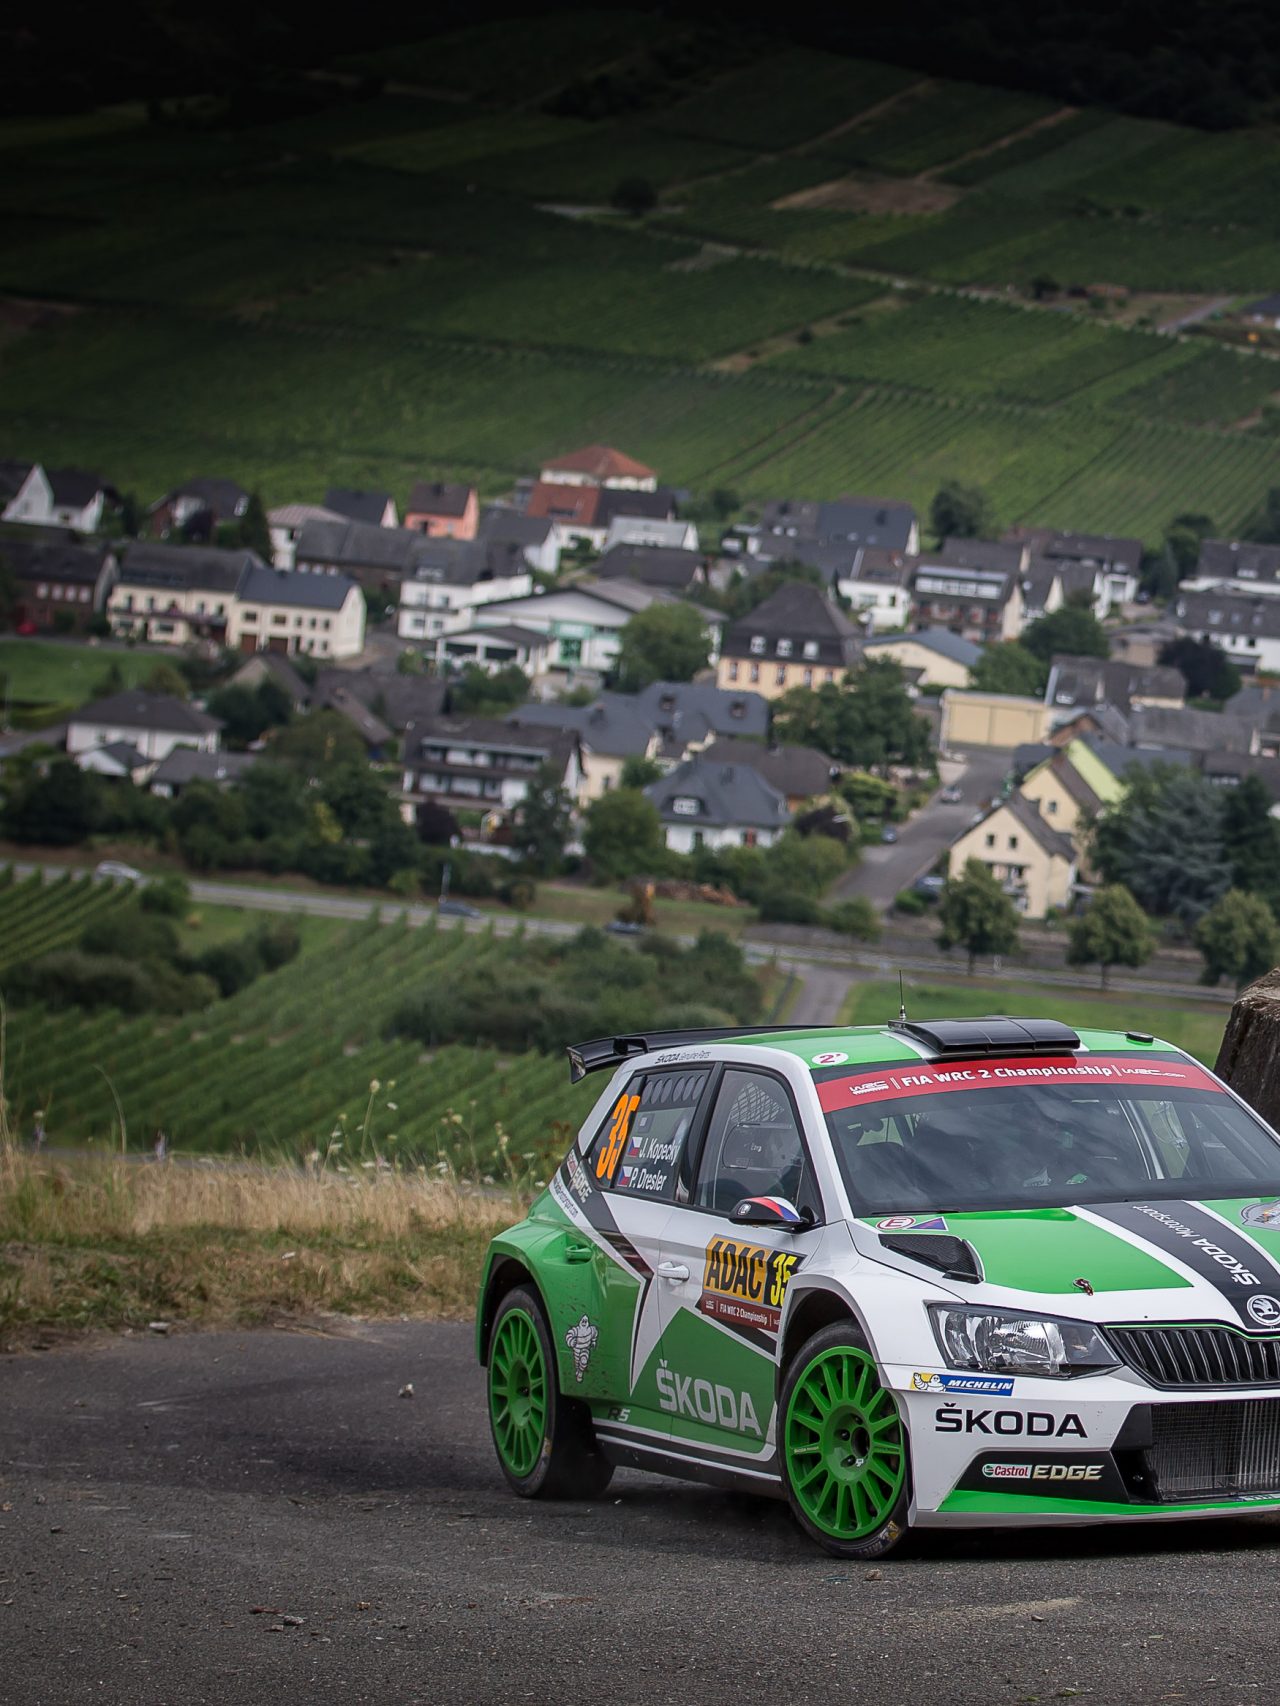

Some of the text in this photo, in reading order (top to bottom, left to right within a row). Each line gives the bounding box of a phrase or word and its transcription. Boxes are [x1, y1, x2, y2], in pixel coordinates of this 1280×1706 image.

[901, 1076, 933, 1087] FIA
[933, 1070, 977, 1083] WRC
[978, 1069, 991, 1079] 2
[994, 1065, 1113, 1078] Championship
[596, 1094, 640, 1179] 35
[639, 1138, 647, 1157] J.
[573, 1166, 592, 1204] EDGE
[628, 1168, 667, 1191] P. Dresler
[1132, 1205, 1261, 1285] ŠKODA Motorsport
[706, 1241, 798, 1306] ADAC 35
[656, 1359, 762, 1437] ŠKODA
[947, 1379, 1013, 1390] MICHELIN
[608, 1407, 630, 1422] R5
[935, 1402, 1088, 1438] ŠKODA
[994, 1464, 1104, 1480] Castrol EDGE
